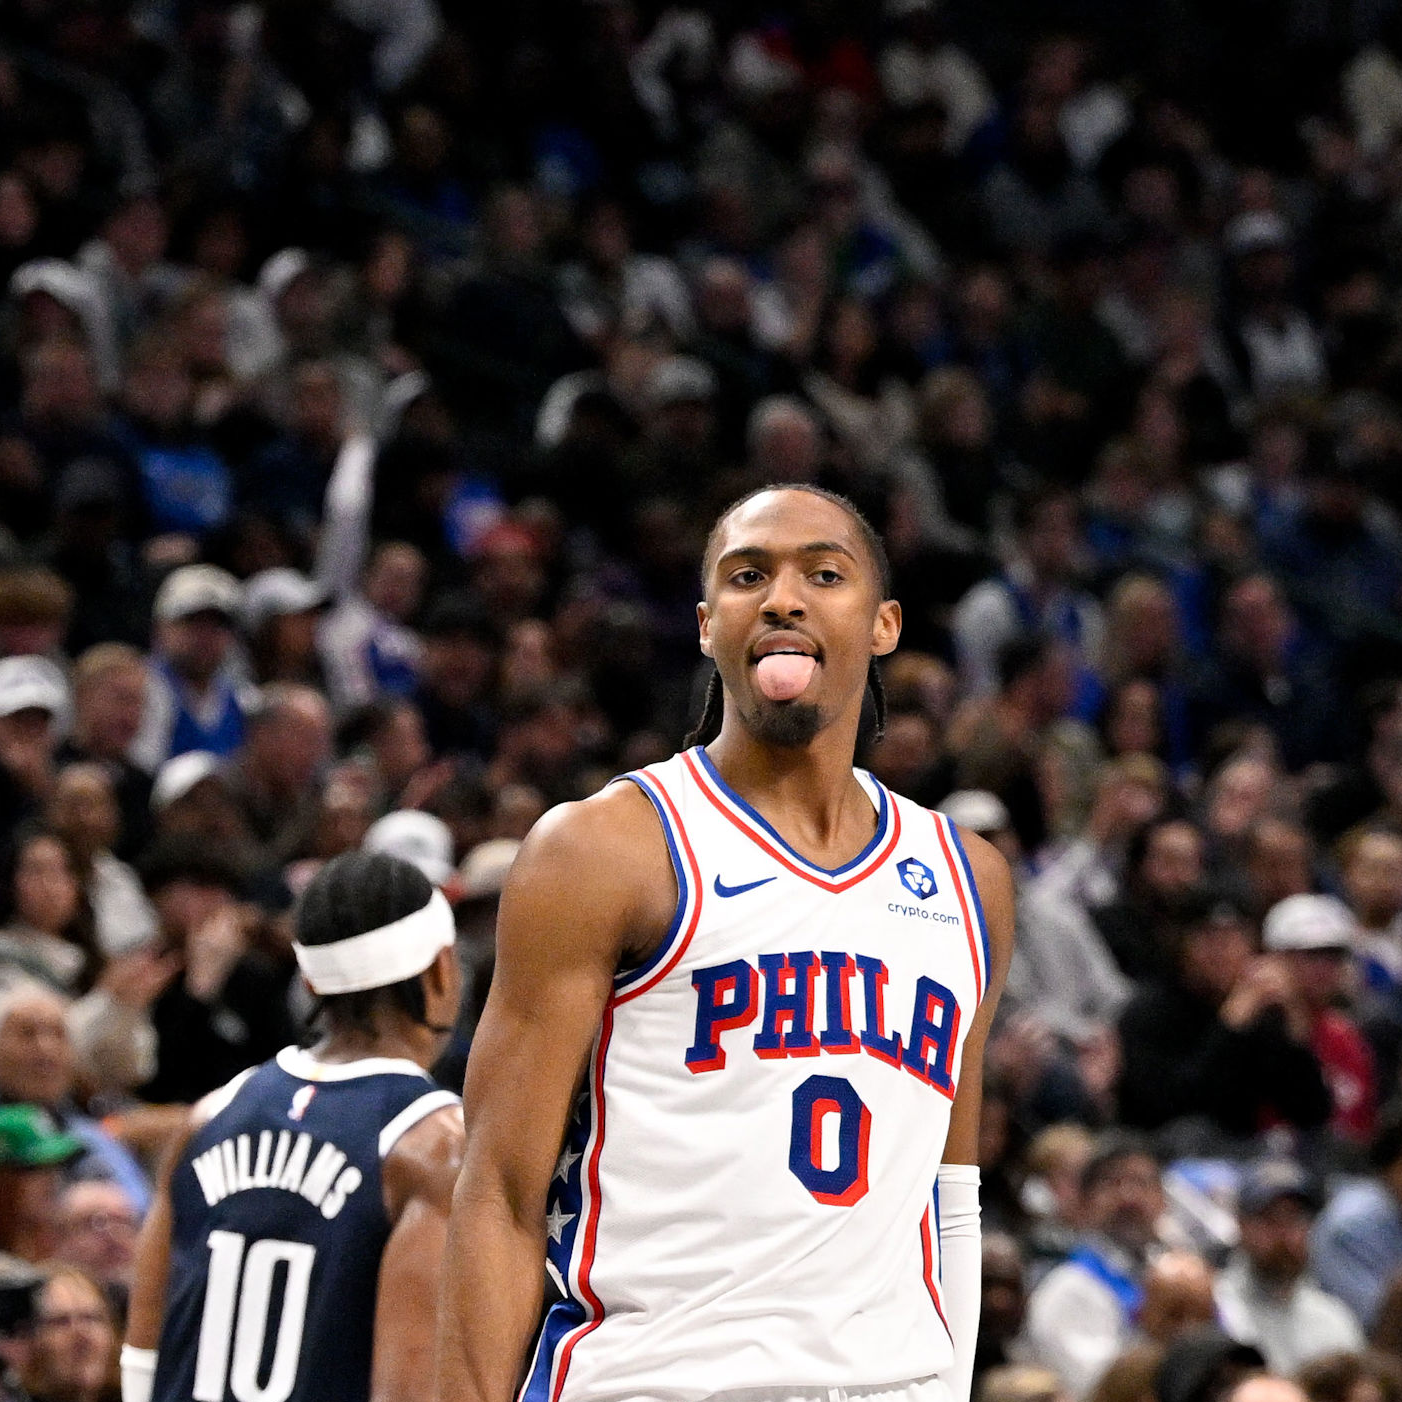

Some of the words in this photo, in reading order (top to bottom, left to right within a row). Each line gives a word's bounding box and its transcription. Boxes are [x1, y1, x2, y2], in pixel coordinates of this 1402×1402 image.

[887, 902, 960, 926] crypto.com
[684, 950, 961, 1101] PHILA
[192, 1129, 363, 1220] WILLIAMS
[788, 1074, 872, 1208] 0
